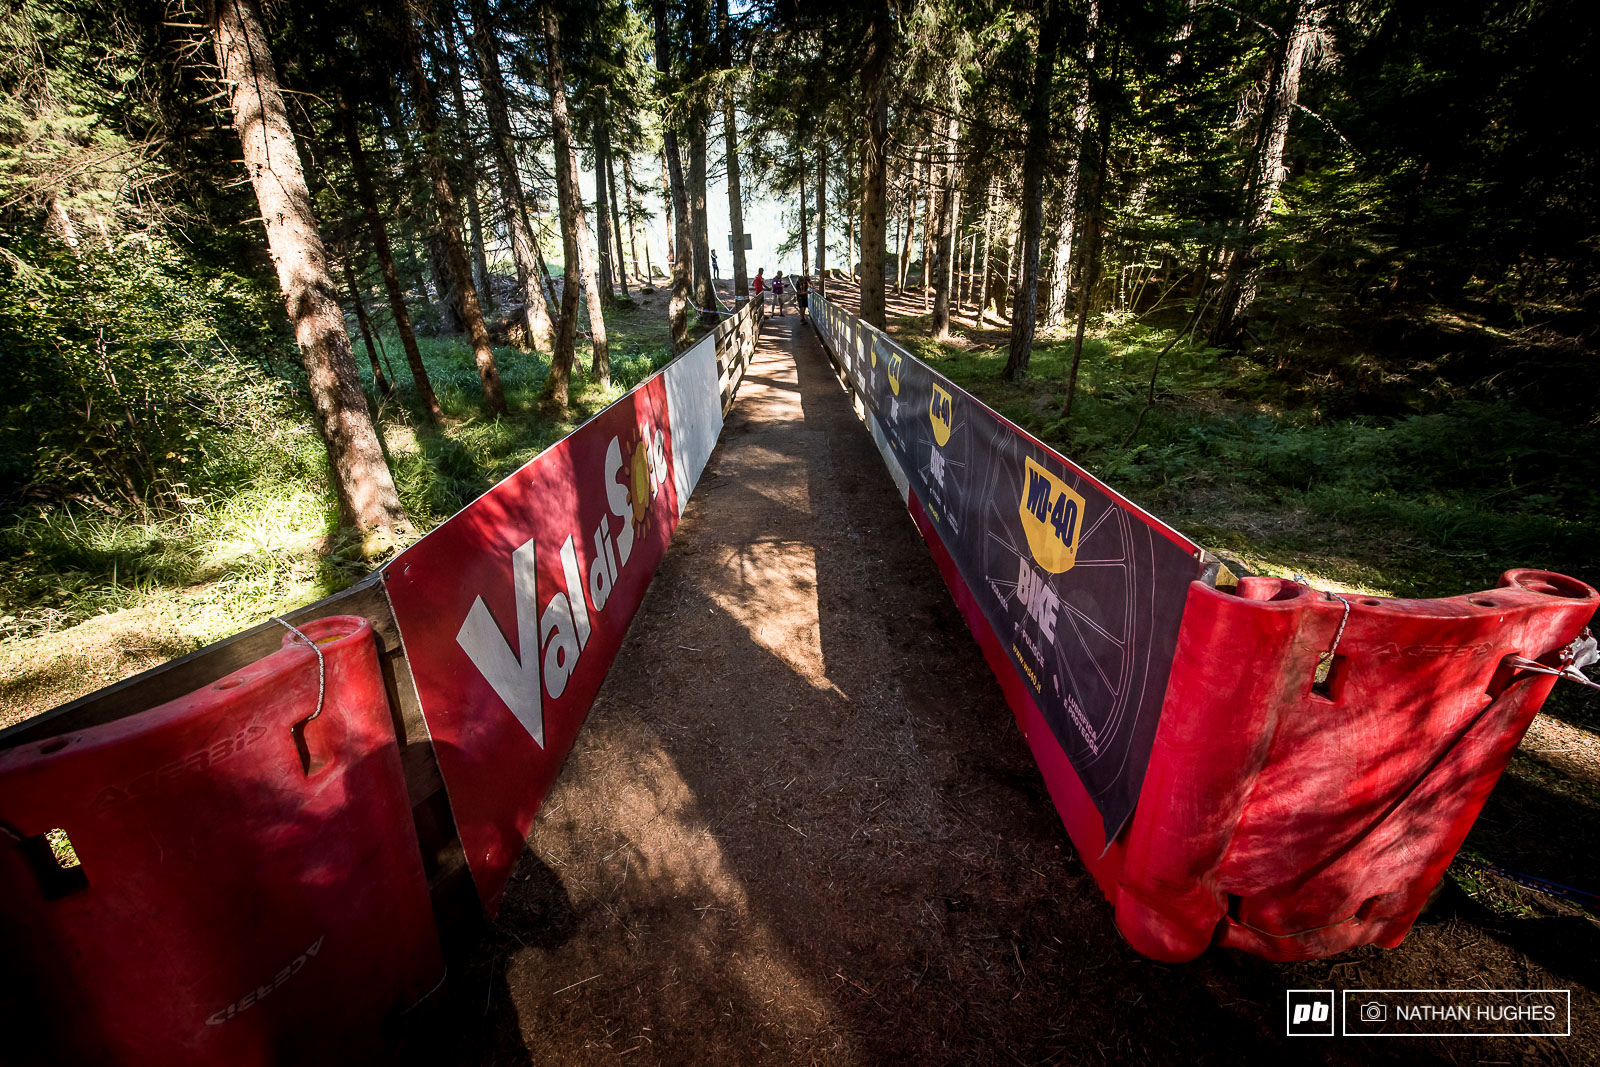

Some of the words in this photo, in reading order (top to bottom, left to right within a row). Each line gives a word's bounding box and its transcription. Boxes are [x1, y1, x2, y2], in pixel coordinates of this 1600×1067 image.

[1026, 467, 1078, 548] WD-40
[1016, 556, 1060, 646] BIKE
[1067, 693, 1097, 742] LUBRIFICA
